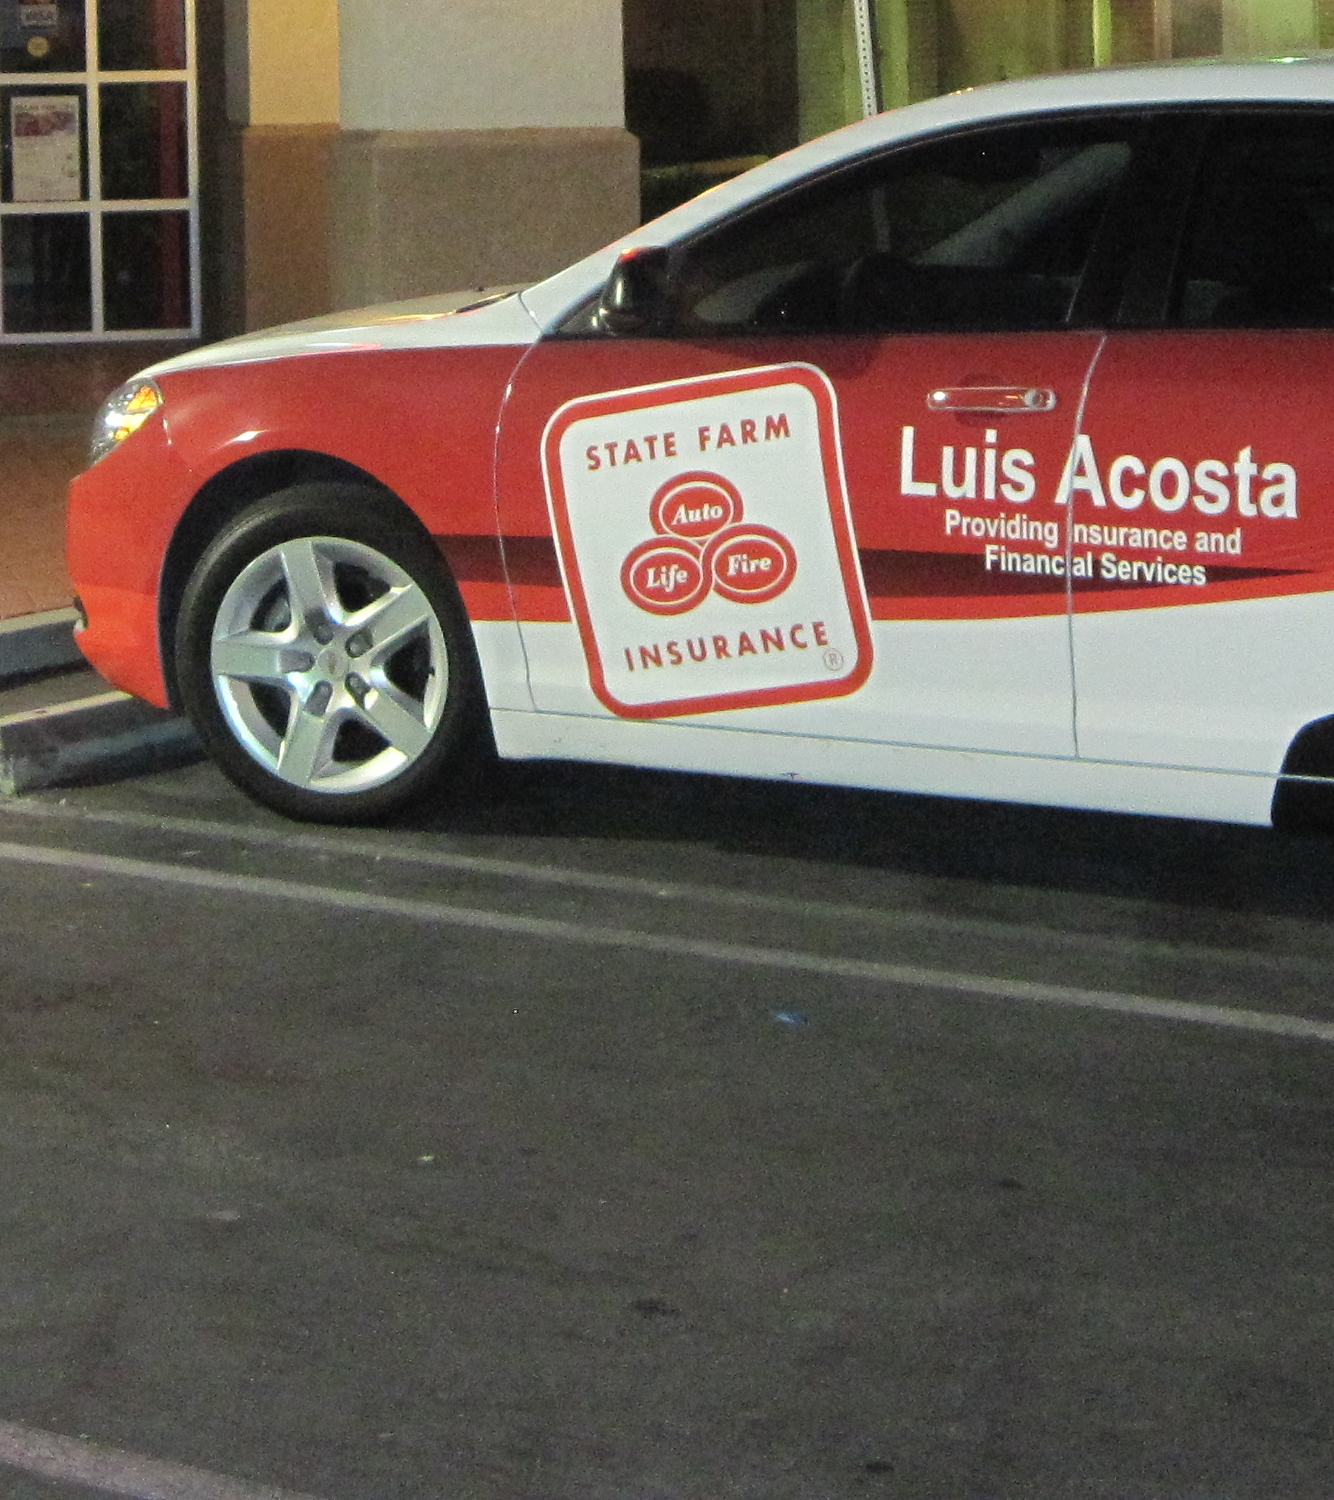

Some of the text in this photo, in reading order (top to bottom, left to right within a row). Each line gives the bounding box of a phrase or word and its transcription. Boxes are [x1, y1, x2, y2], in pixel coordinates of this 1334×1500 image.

[586, 413, 792, 471] STATE FARM
[900, 426, 1299, 520] Luis Acosta
[671, 502, 724, 527] Auto
[945, 510, 1242, 555] Providing nsurance and
[645, 566, 689, 592] Life
[726, 552, 773, 578] Fire
[984, 545, 1207, 586] Financal Services
[624, 620, 830, 672] INSURANCE
